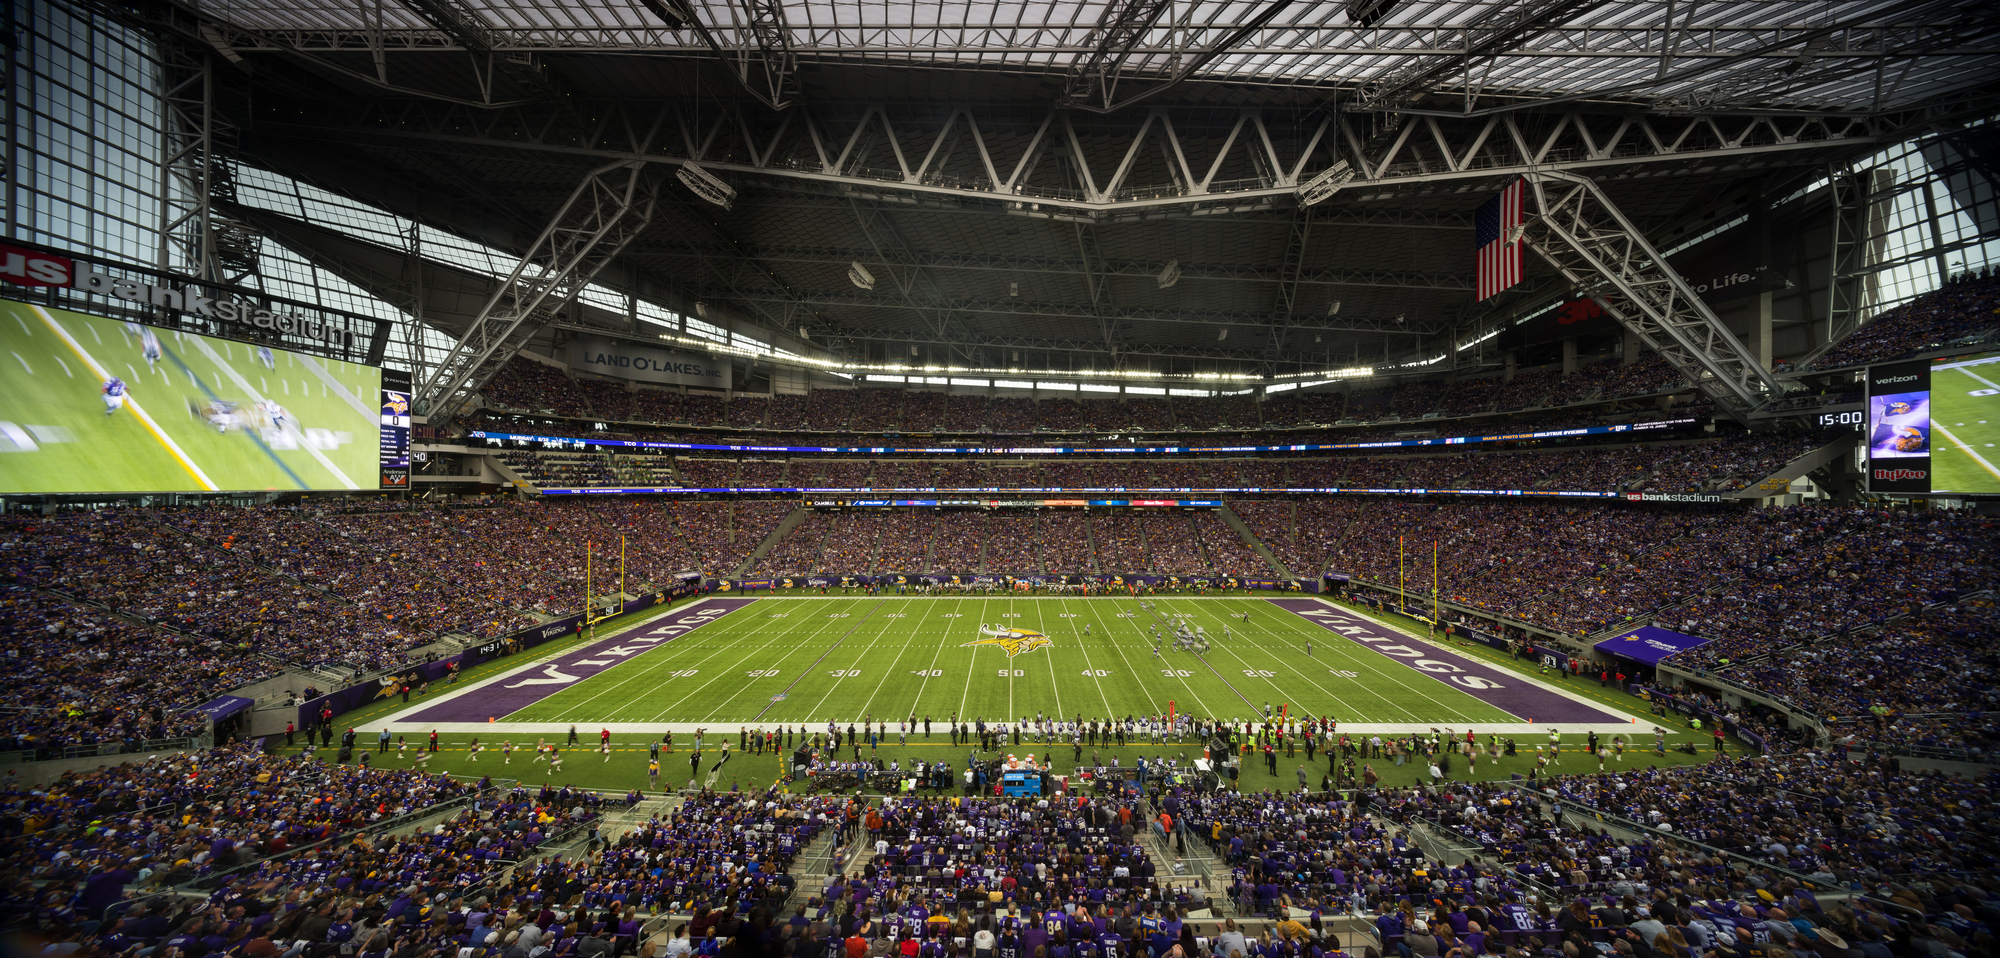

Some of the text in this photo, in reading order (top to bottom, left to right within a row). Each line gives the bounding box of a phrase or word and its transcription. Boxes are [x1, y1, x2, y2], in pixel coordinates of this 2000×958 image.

[584, 351, 630, 368] LAND
[1875, 374, 1918, 385] verizon
[1819, 412, 1862, 426] 15:00
[504, 608, 726, 689] VIKINGS
[1297, 609, 1505, 689] VIKINGS
[1047, 920, 1061, 935] 84
[1512, 912, 1534, 929] 82
